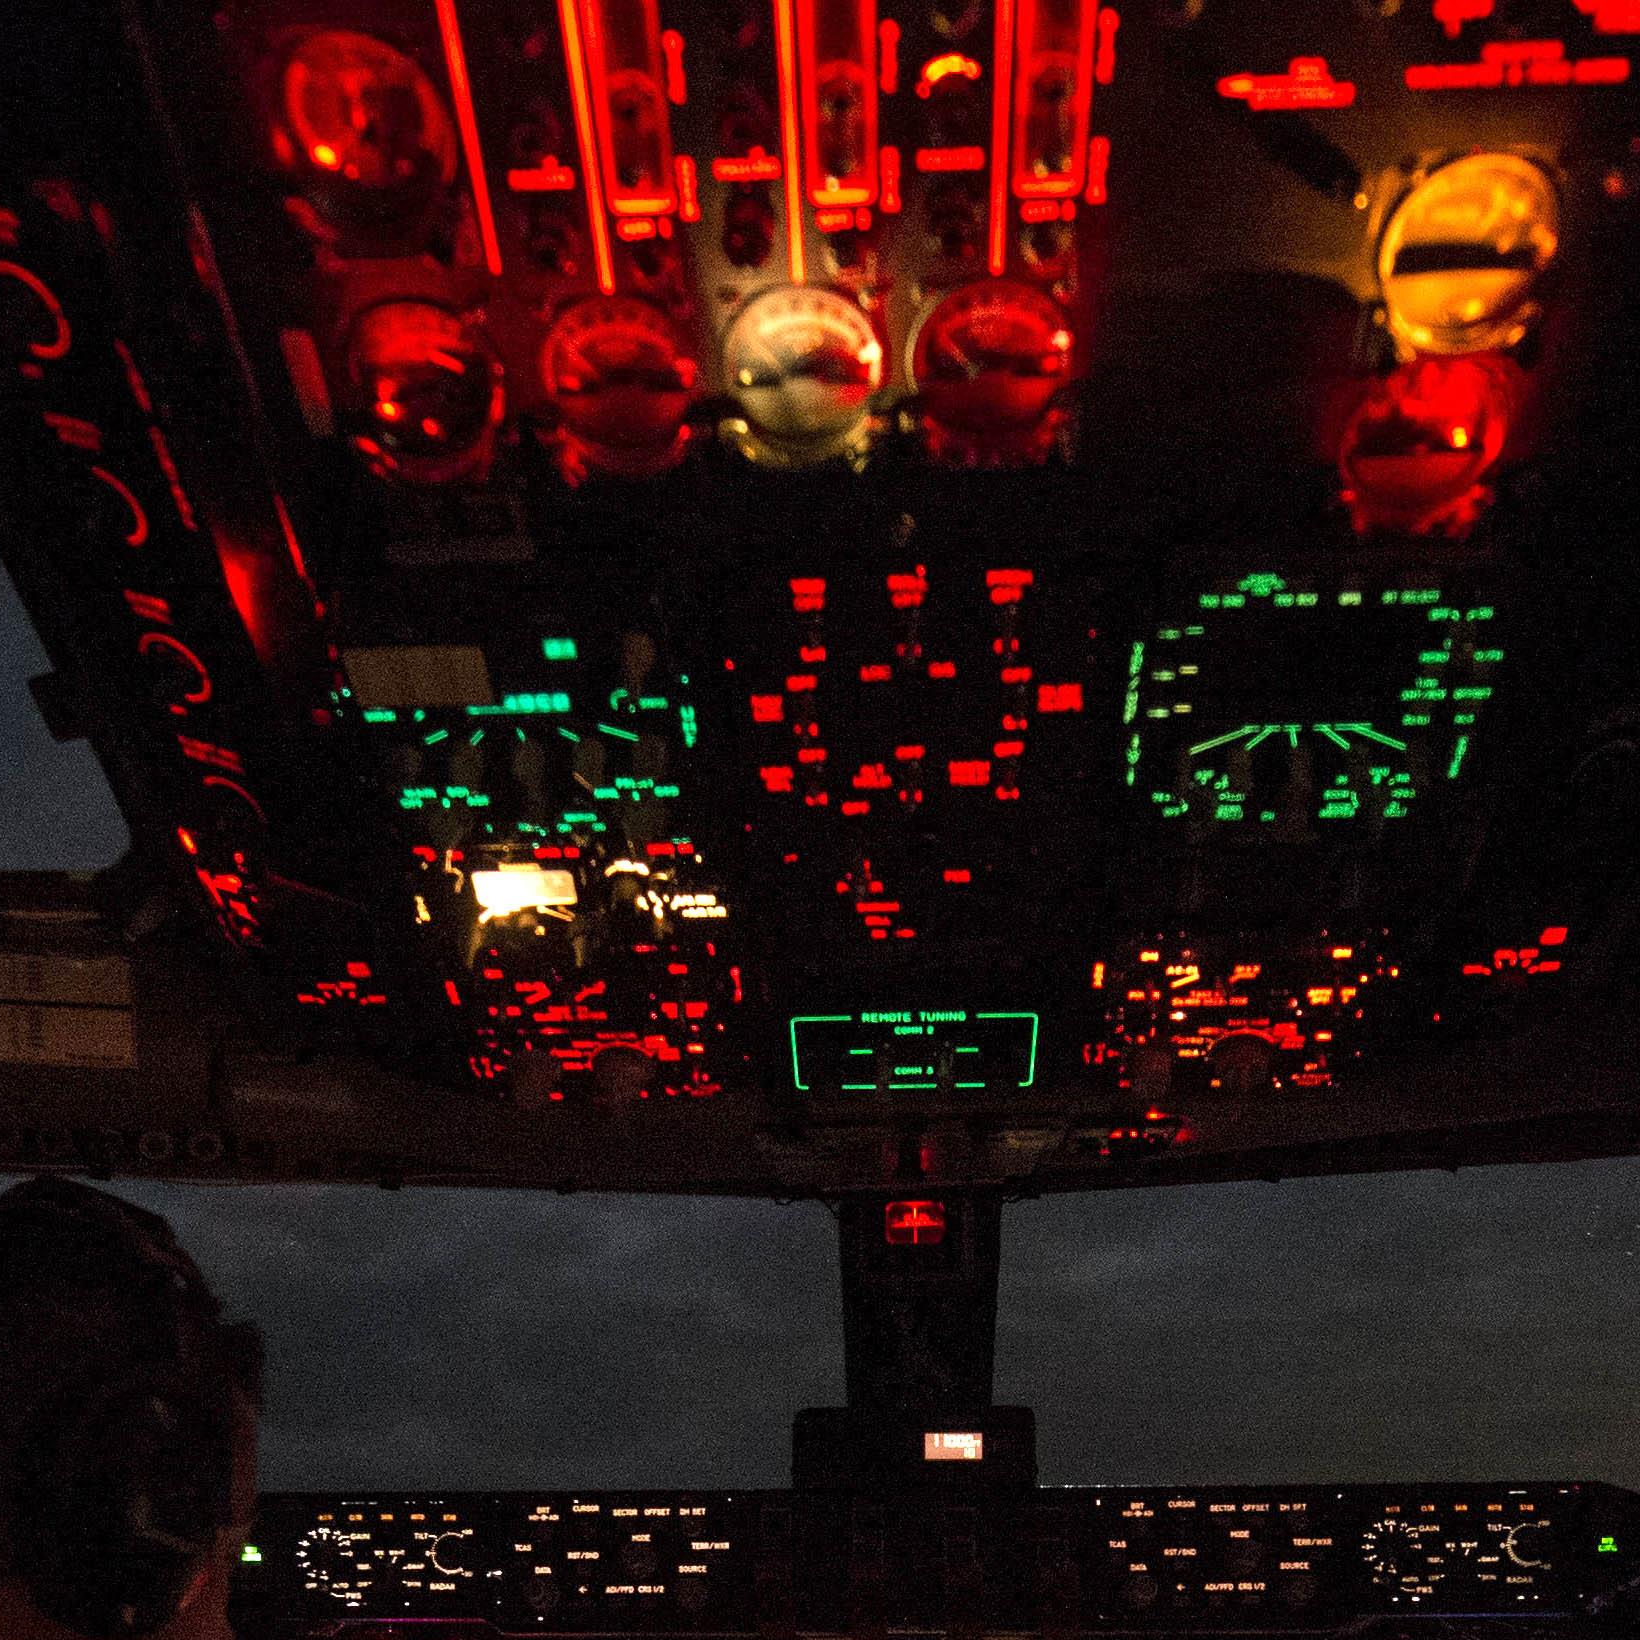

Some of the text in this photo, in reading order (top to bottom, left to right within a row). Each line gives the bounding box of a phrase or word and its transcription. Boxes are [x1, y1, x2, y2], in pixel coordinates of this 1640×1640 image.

[862, 1011, 966, 1023] REMOTE TUNING
[1168, 1500, 1196, 1508] CURSOR
[1242, 1504, 1269, 1512] OFFSET
[572, 1505, 600, 1513] CURSOR
[644, 1508, 670, 1516] OFFSET
[1230, 1530, 1250, 1538] MODE
[515, 1544, 532, 1552] TCAS
[1109, 1540, 1127, 1548] TCAS
[679, 1565, 707, 1573] SOURCE
[1279, 1562, 1309, 1570] SOURCE
